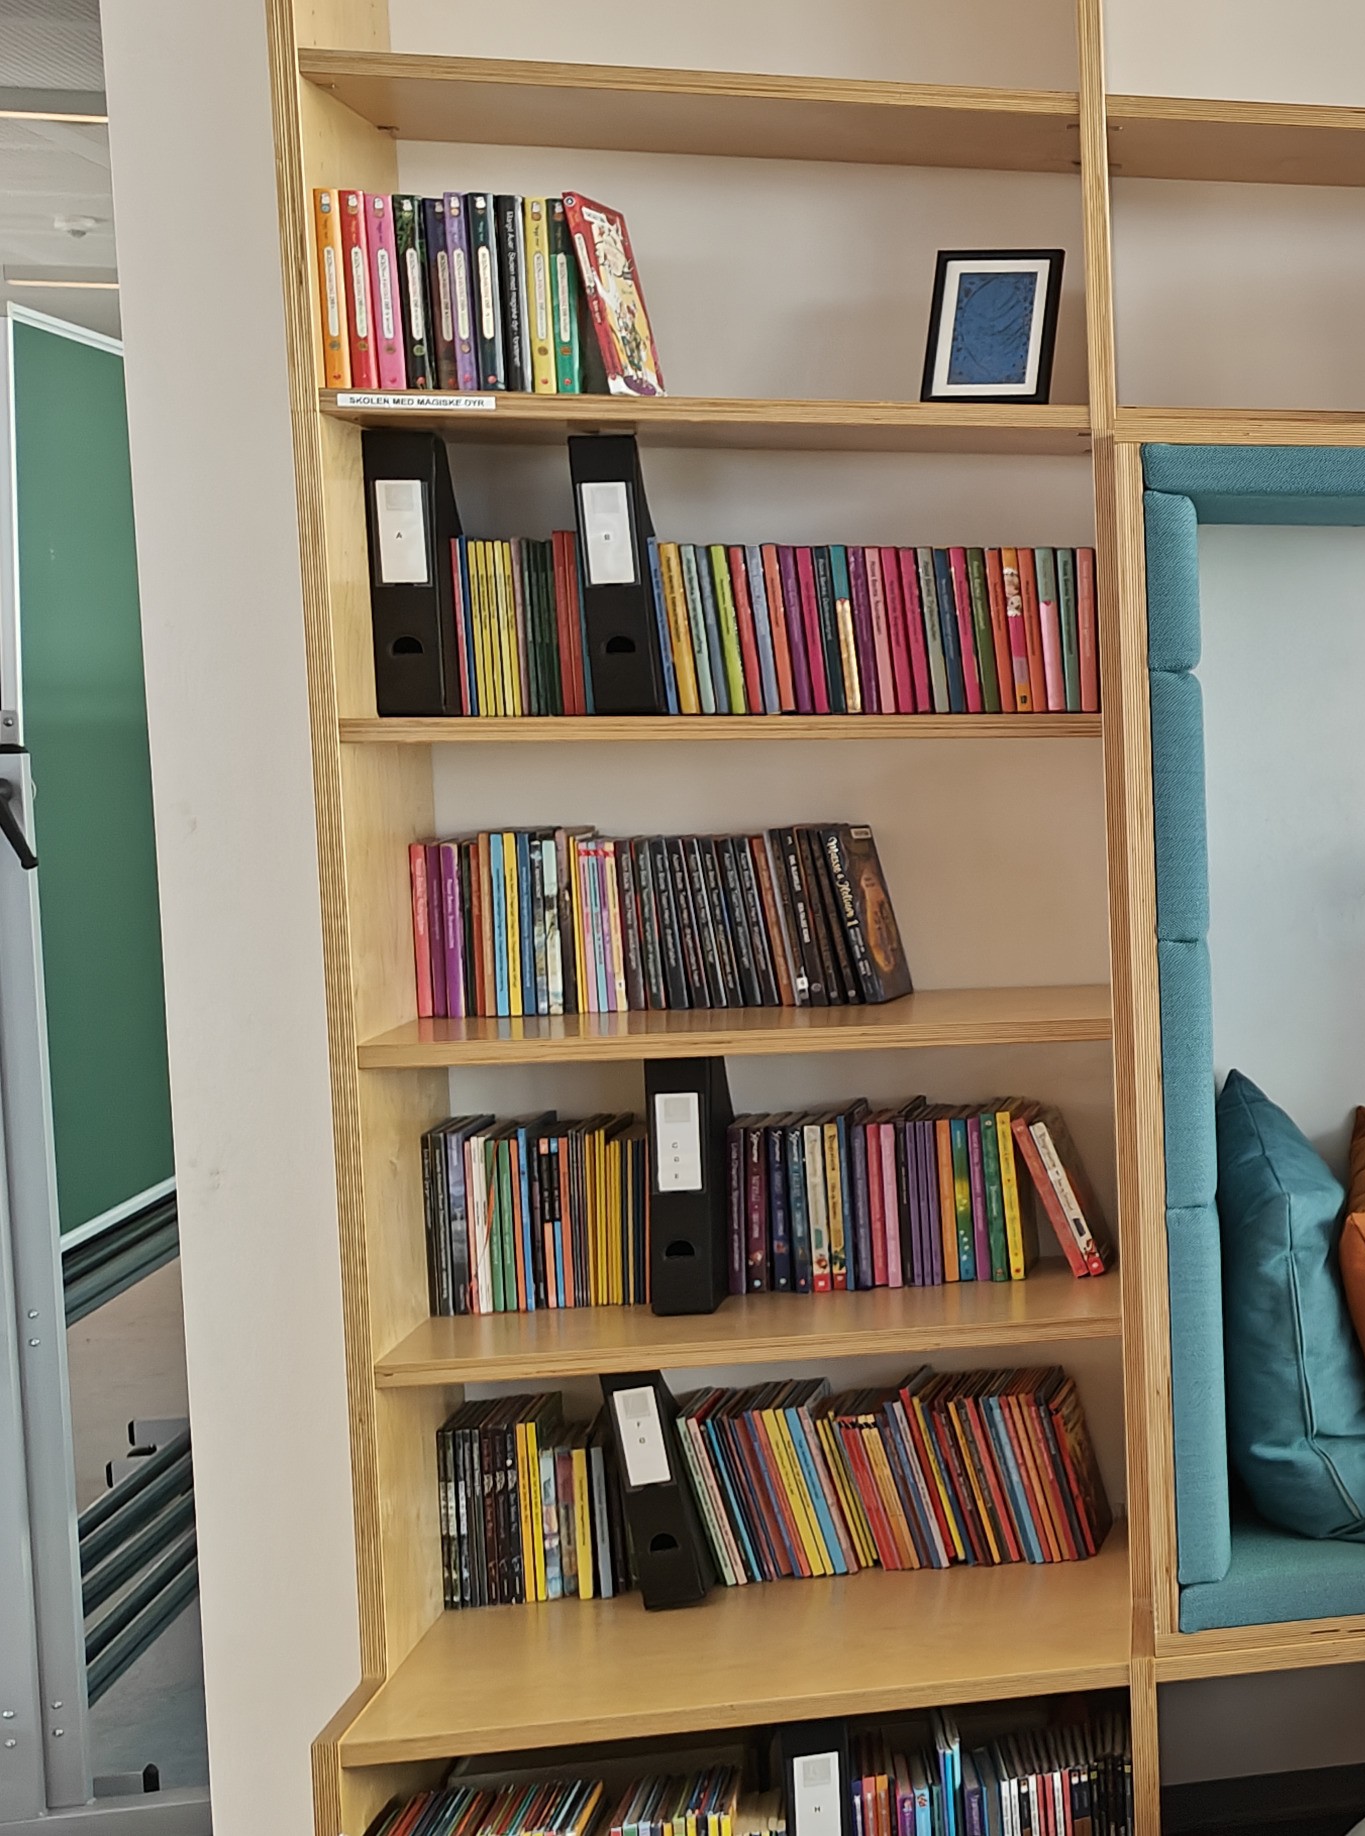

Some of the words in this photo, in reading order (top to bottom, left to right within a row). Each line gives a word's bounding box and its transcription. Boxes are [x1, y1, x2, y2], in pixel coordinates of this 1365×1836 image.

[349, 397, 389, 405] SKOLEN
[417, 398, 461, 406] MAGISKE
[464, 399, 485, 407] DYR
